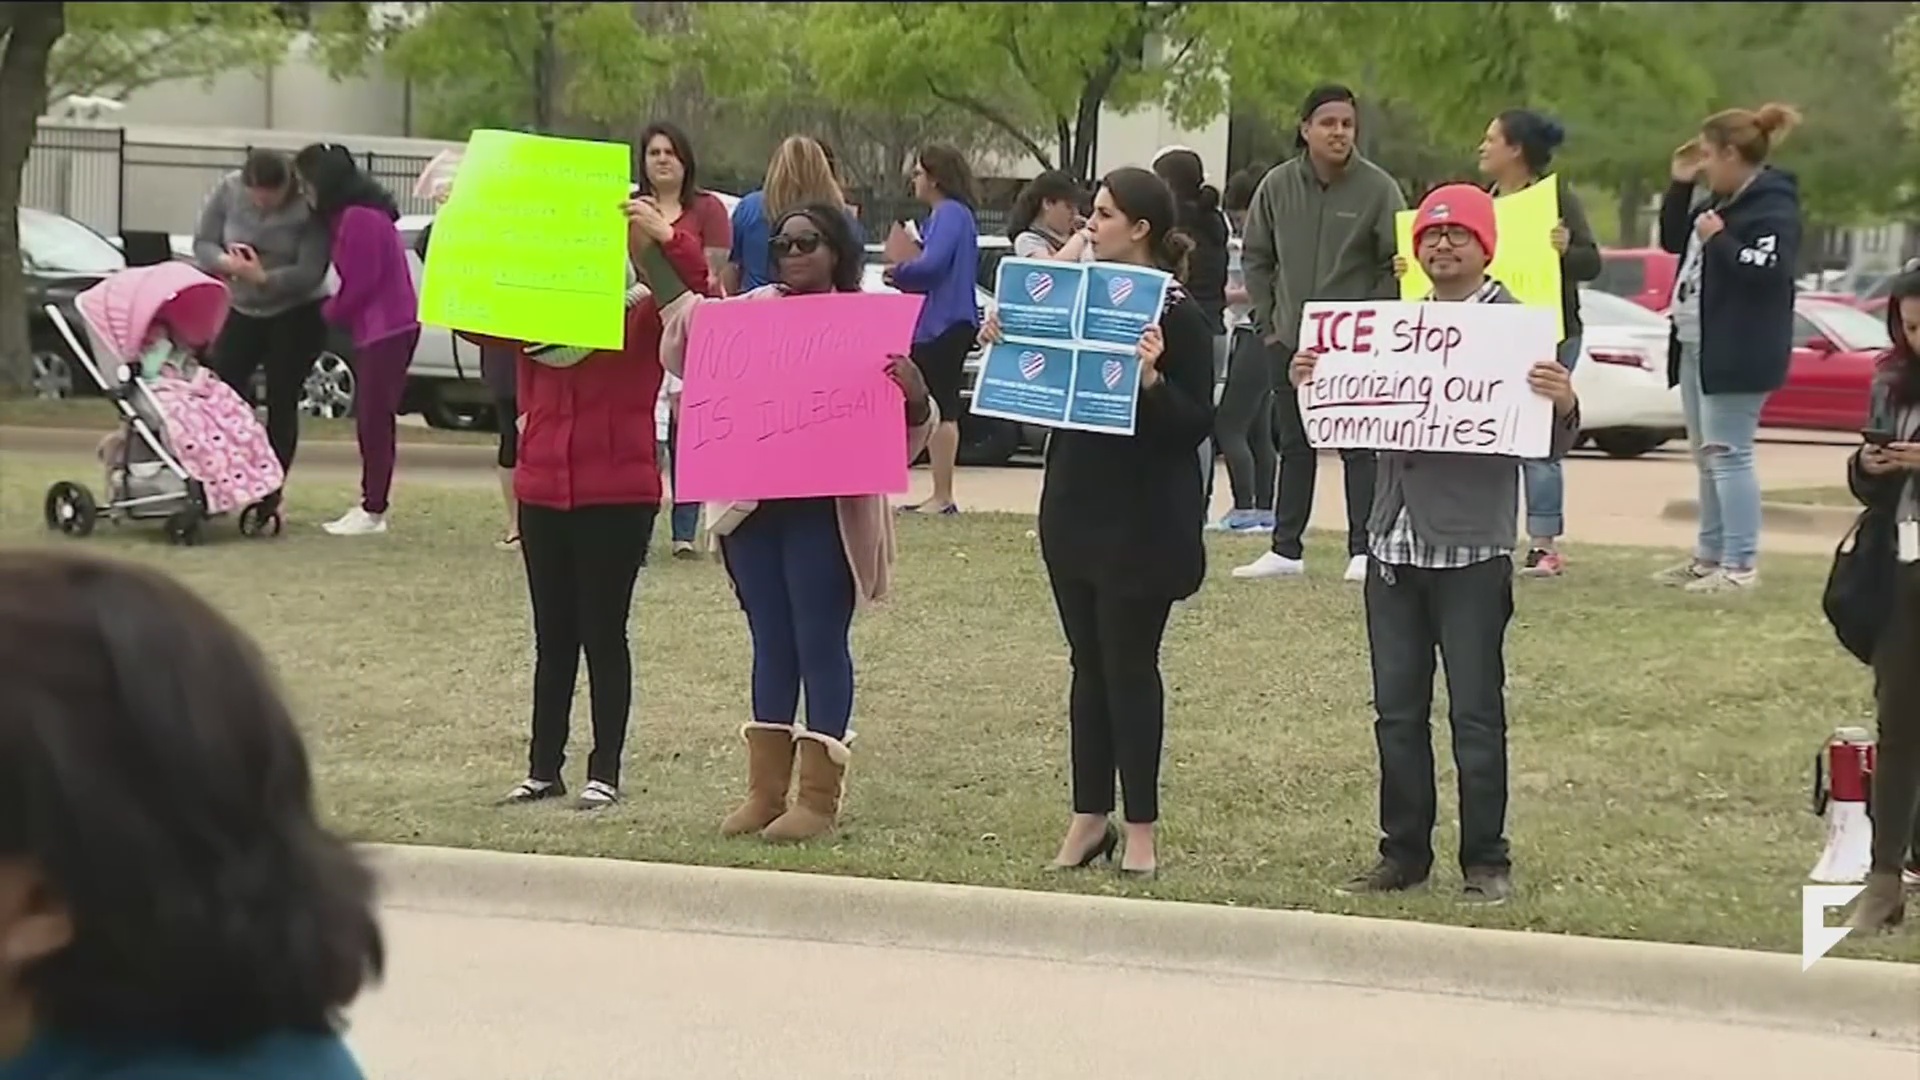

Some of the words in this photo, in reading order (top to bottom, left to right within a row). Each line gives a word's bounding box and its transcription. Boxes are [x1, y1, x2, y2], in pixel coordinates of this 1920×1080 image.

[697, 327, 751, 380] NO
[1443, 376, 1503, 403] our
[687, 396, 732, 450] IS
